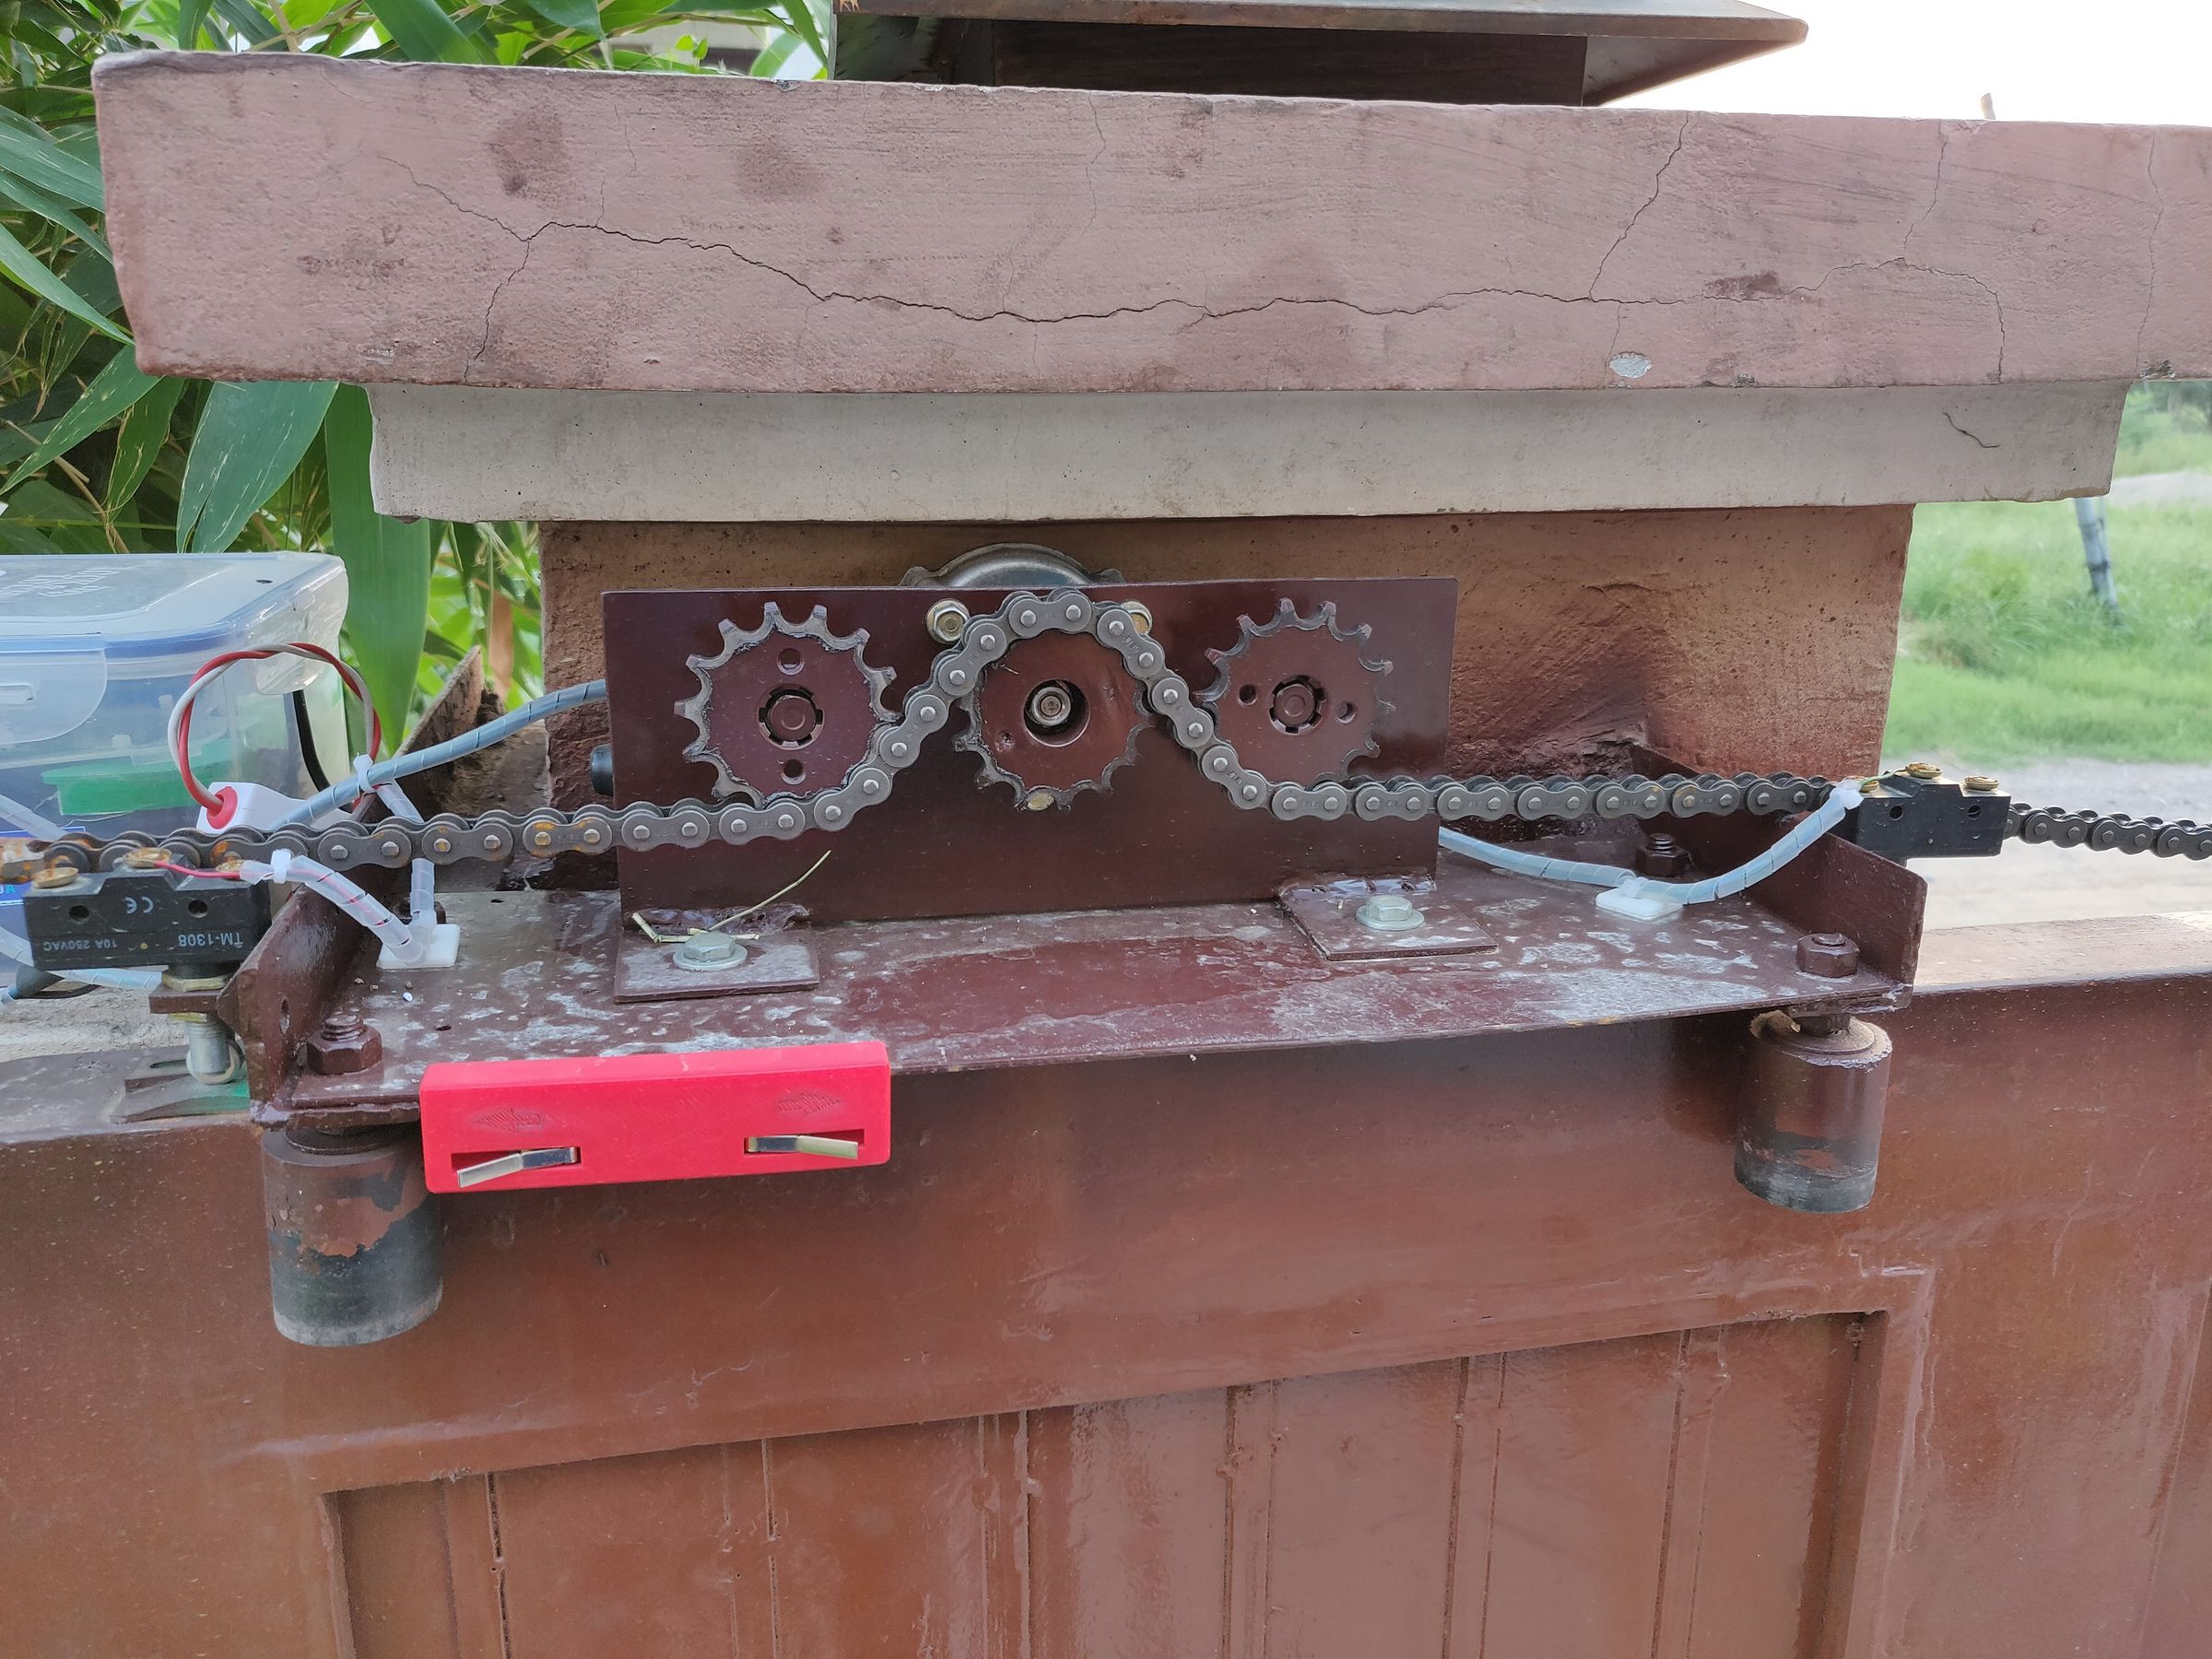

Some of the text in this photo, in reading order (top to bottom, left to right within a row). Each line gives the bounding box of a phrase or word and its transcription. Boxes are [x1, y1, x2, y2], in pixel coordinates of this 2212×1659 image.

[124, 896, 154, 914] CE
[42, 939, 118, 952] 10A 250VAC
[178, 932, 243, 947] TM-1308
